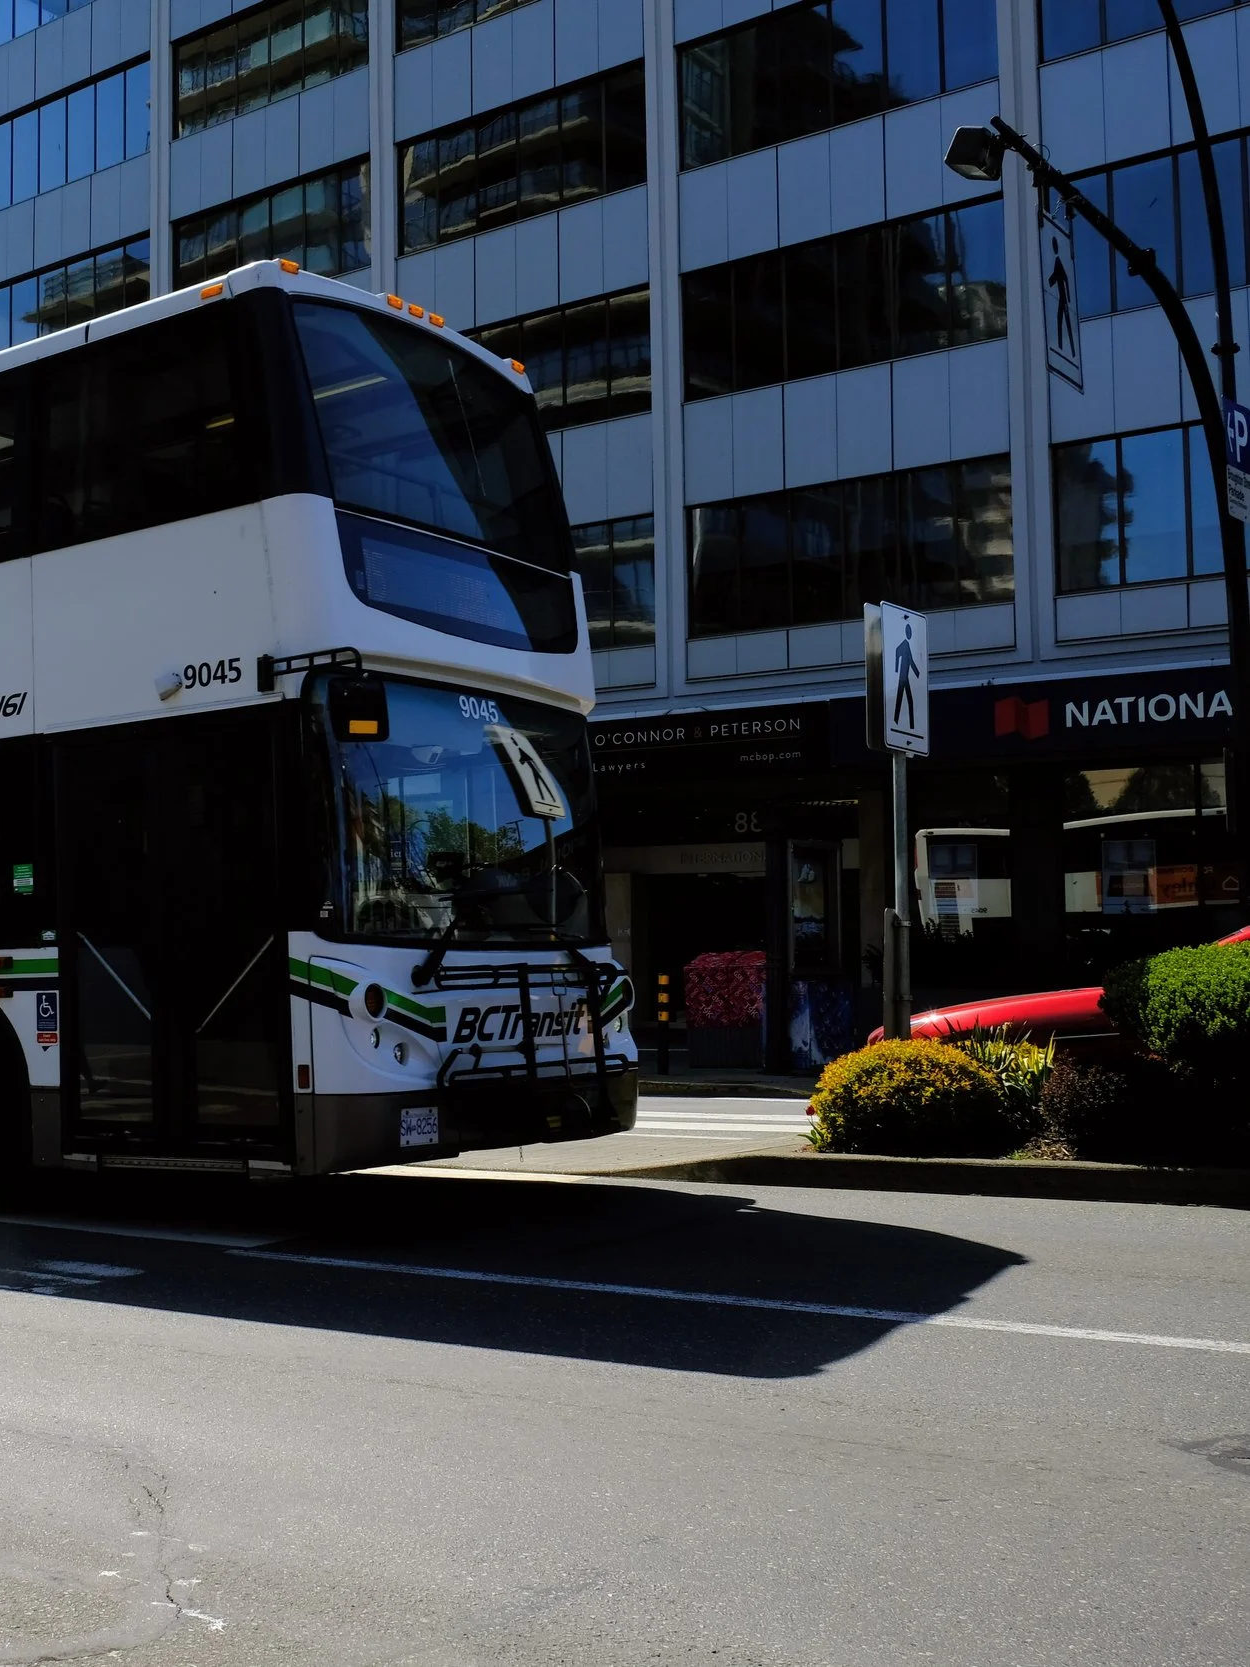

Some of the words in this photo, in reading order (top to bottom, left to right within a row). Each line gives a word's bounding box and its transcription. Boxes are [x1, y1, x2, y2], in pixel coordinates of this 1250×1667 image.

[182, 657, 242, 690] 9045
[458, 694, 499, 724] 9045
[594, 727, 686, 746] O'CONNOR
[709, 717, 801, 738] PETERSON
[592, 760, 646, 774] Lawyers
[739, 750, 802, 764] mcbop.com
